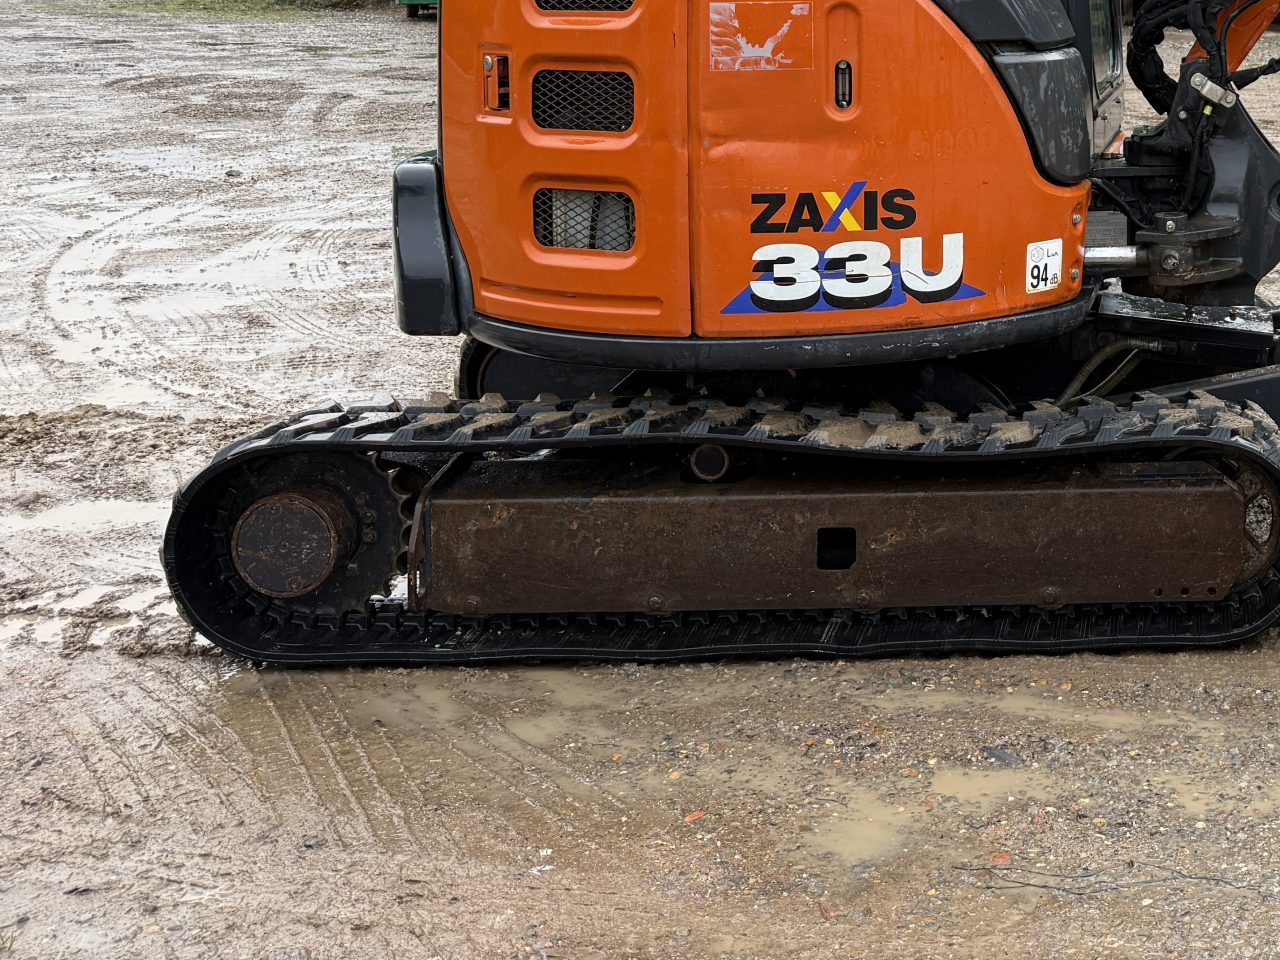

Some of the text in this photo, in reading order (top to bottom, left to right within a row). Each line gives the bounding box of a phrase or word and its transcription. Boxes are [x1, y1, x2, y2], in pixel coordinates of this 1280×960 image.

[750, 181, 917, 234] ZAXIS
[750, 232, 964, 310] 33U
[1030, 263, 1059, 289] 94 dB
